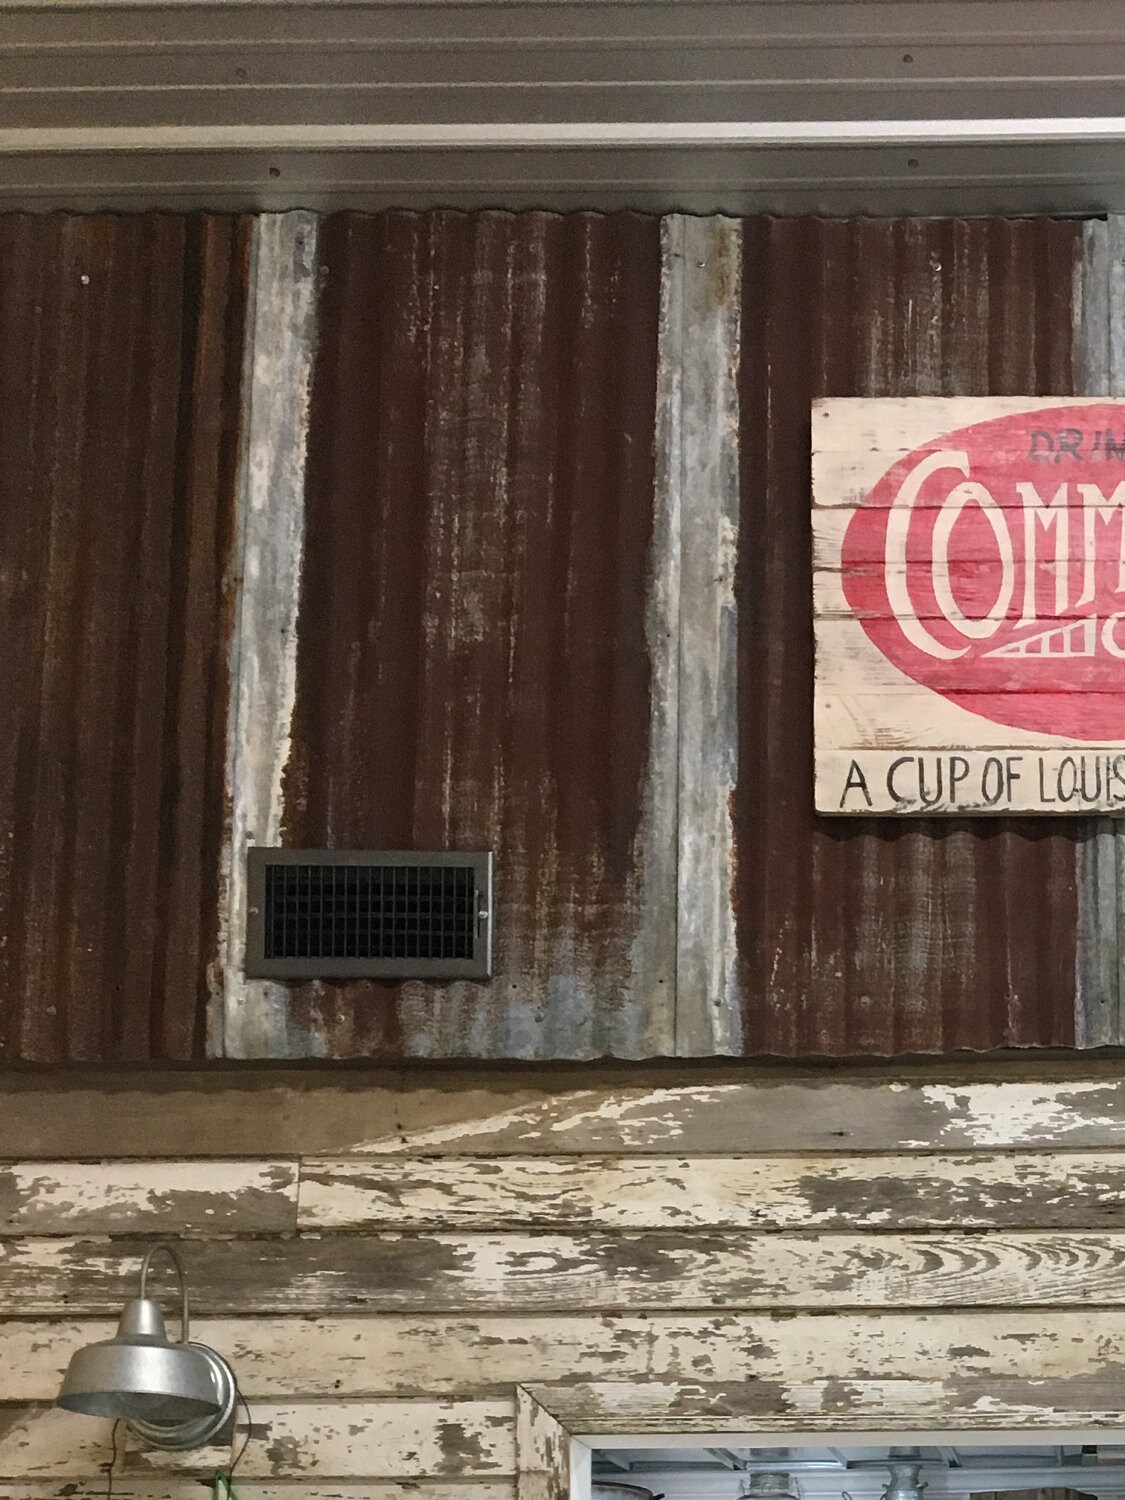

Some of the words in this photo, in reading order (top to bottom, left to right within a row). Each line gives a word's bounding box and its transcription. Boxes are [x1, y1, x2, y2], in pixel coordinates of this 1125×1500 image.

[838, 758, 872, 808] A
[886, 753, 970, 803] CUP
[981, 755, 1021, 802] OF
